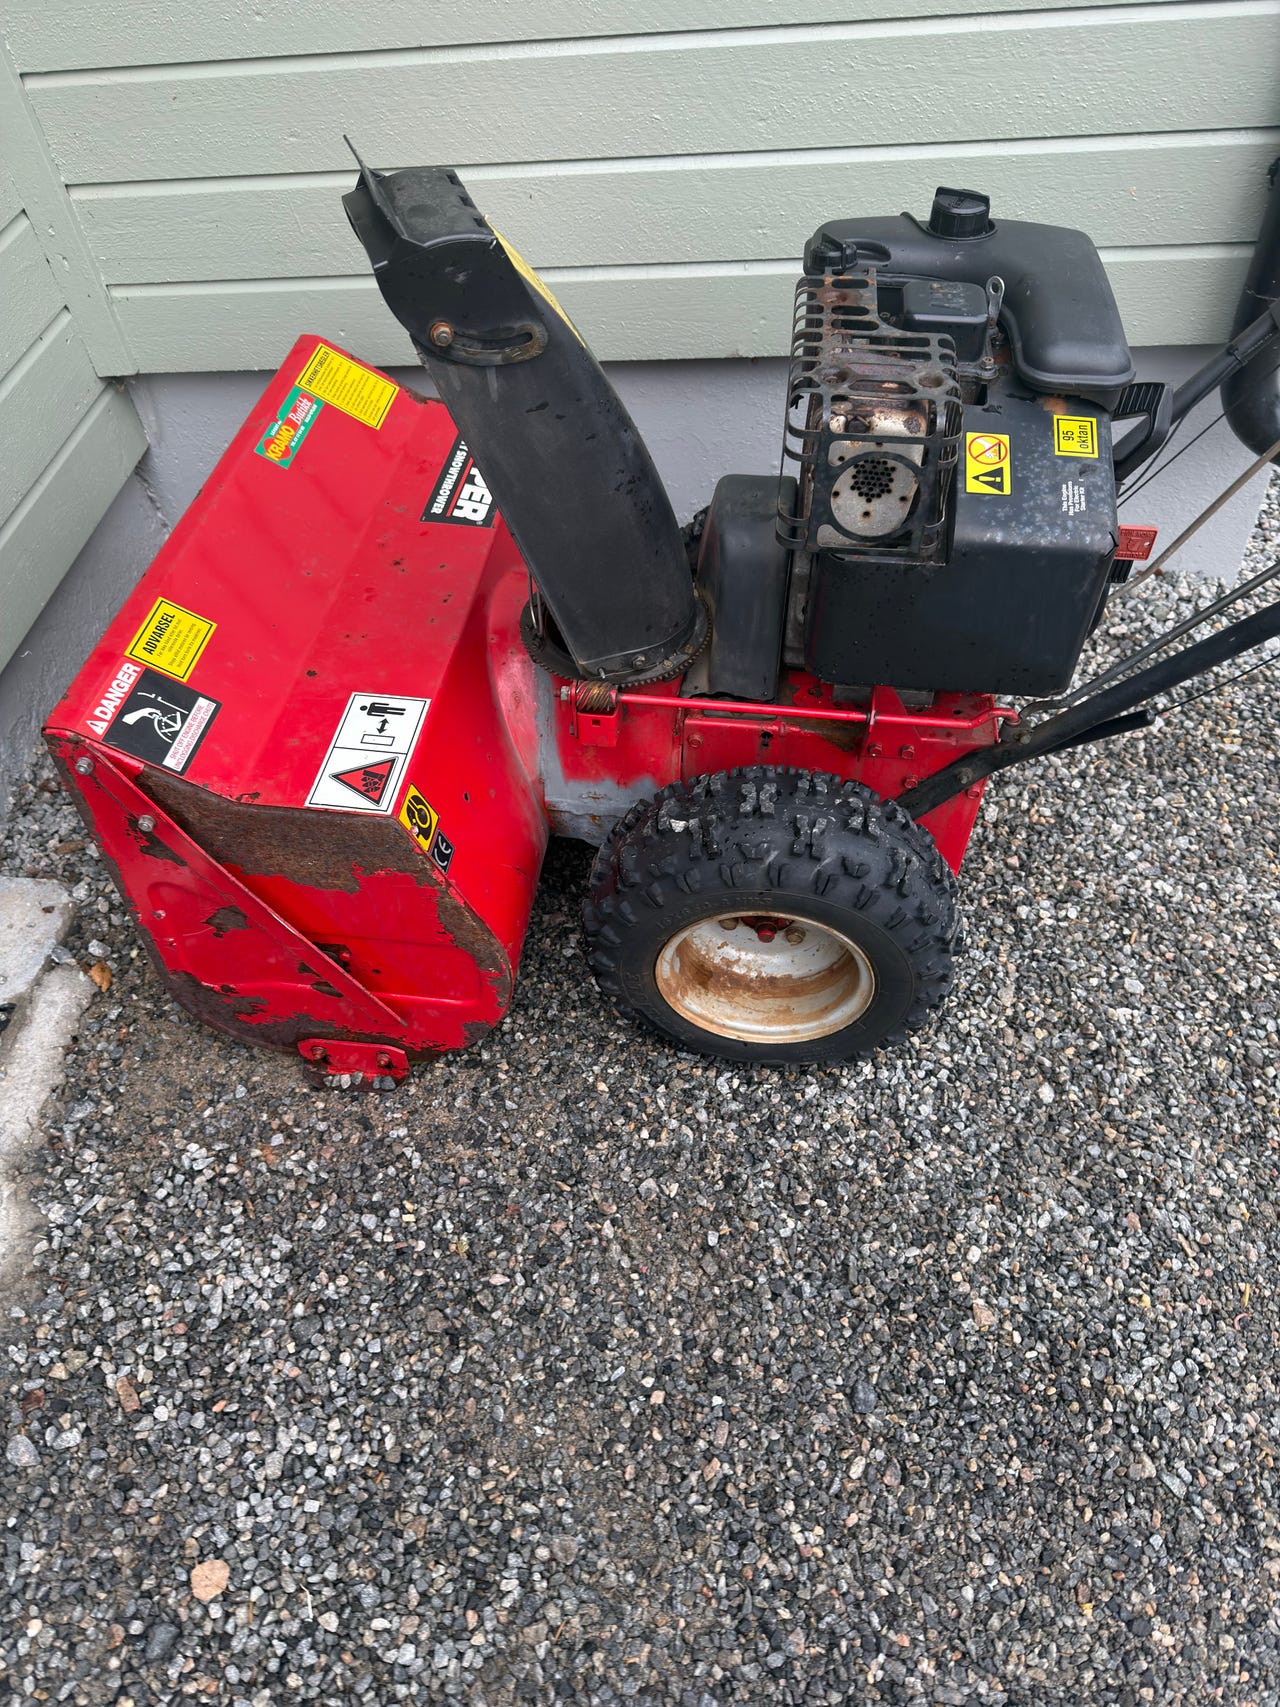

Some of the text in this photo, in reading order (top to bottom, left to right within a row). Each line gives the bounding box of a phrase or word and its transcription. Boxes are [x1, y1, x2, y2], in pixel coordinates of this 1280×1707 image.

[265, 425, 295, 462] KRAMO
[1062, 430, 1075, 442] 95
[1077, 424, 1089, 449] oktan
[431, 450, 467, 515] SNOWTHROWER
[142, 612, 176, 656] ADVARSEL
[93, 662, 142, 721] DANGER
